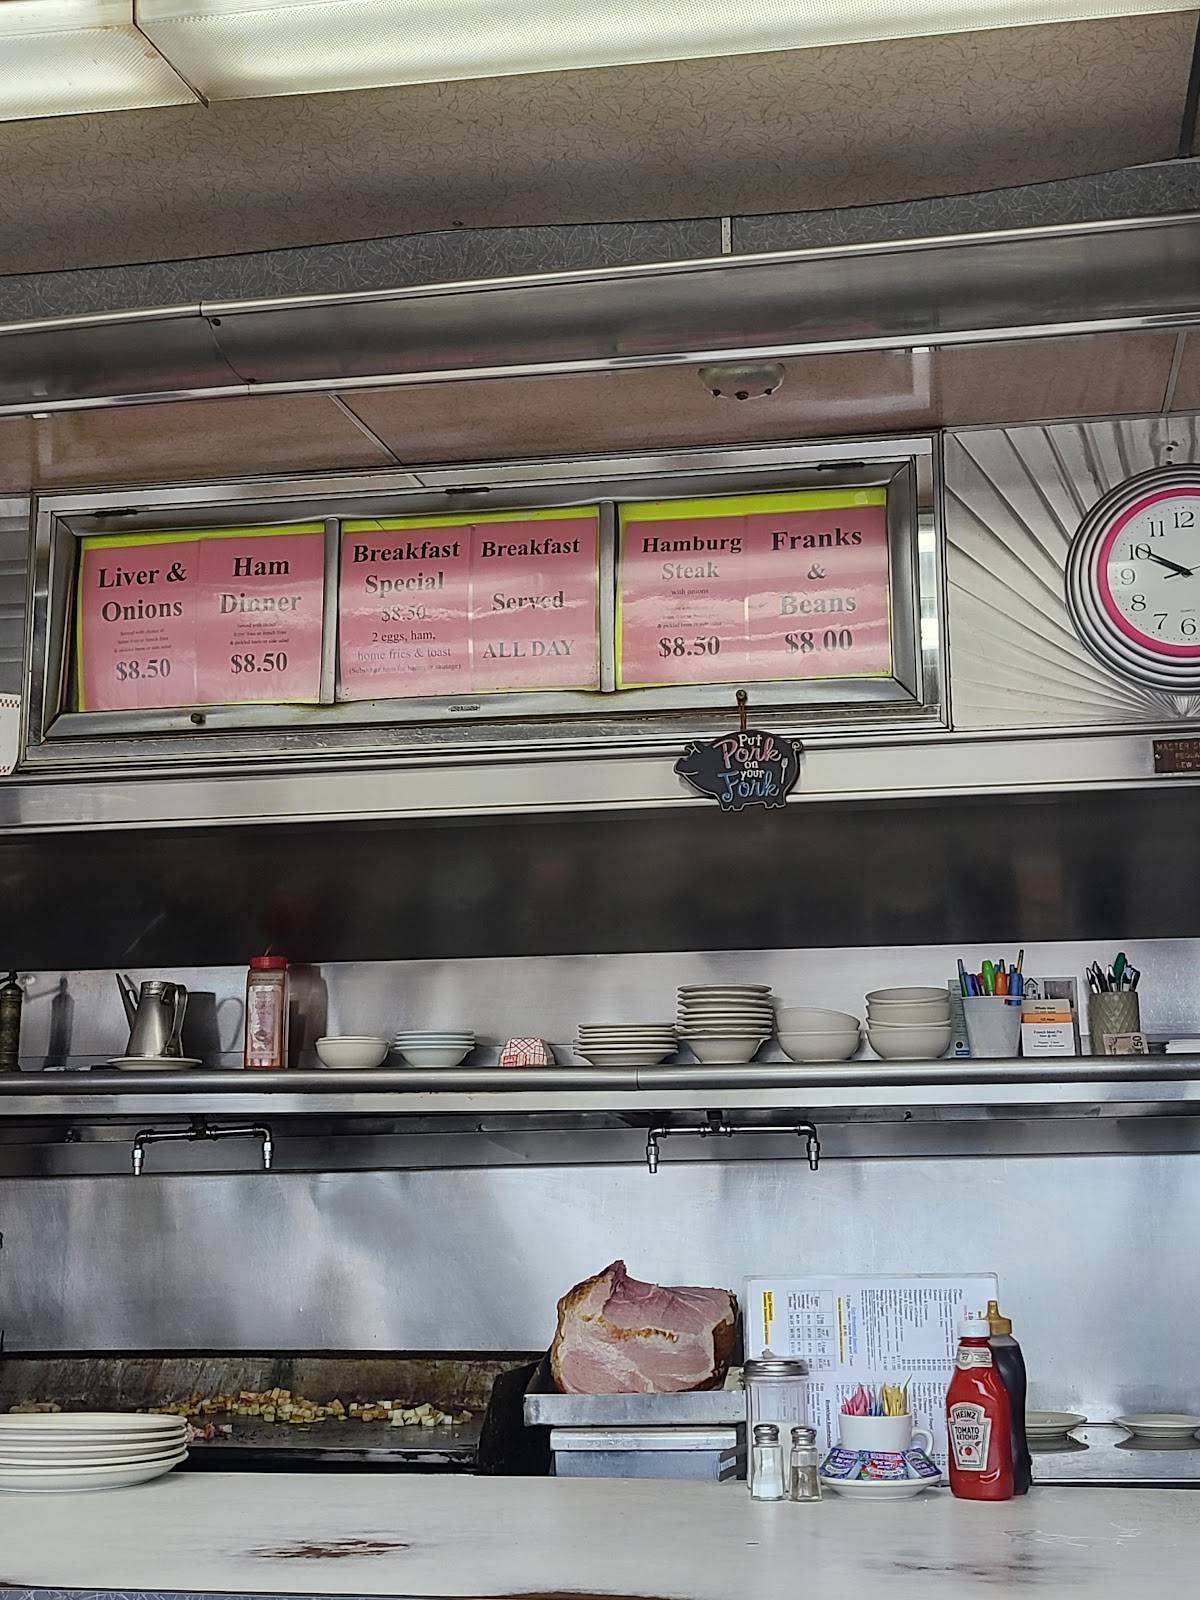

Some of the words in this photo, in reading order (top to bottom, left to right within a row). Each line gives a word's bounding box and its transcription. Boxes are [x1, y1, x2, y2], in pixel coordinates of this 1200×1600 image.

[1149, 520, 1165, 537] 11
[1174, 511, 1194, 529] 12
[481, 537, 580, 557] Breakfast
[642, 536, 742, 553] Hamburg
[771, 528, 862, 551] Franks
[353, 541, 461, 563] Breakfast
[1128, 543, 1151, 561] 10
[99, 567, 159, 588] Liver
[166, 563, 187, 583] &
[233, 557, 289, 577] Ham
[662, 561, 720, 582] Steak
[807, 563, 826, 580] &
[365, 572, 444, 598] Special
[1120, 568, 1135, 585] 9
[219, 593, 302, 614] Dinner
[492, 591, 564, 611] Served
[779, 596, 857, 616] Beans
[1131, 594, 1146, 611] 8
[102, 600, 182, 622] Onions
[381, 604, 426, 622] $8.50
[1154, 613, 1168, 630] 7
[1180, 618, 1197, 636] 6
[372, 632, 378, 642] 2
[381, 632, 408, 645] eggs,
[410, 630, 436, 642] ham,
[785, 630, 853, 654] $8.00
[357, 650, 385, 662] home
[390, 648, 412, 660] fries
[414, 648, 424, 658] &
[427, 647, 452, 658] toast
[482, 641, 526, 659] ALL
[531, 640, 575, 657] DAY
[658, 636, 721, 658] $8.50
[116, 658, 171, 682] $8.50
[230, 652, 288, 675] $8.50
[738, 734, 762, 747] Put
[713, 737, 782, 769] Pork
[744, 760, 758, 769] on
[740, 769, 765, 781] your
[717, 771, 779, 803] Fork
[955, 1410, 977, 1420] HEINZ
[954, 1426, 980, 1434] TOMATO
[956, 1433, 979, 1441] KETCHUP
